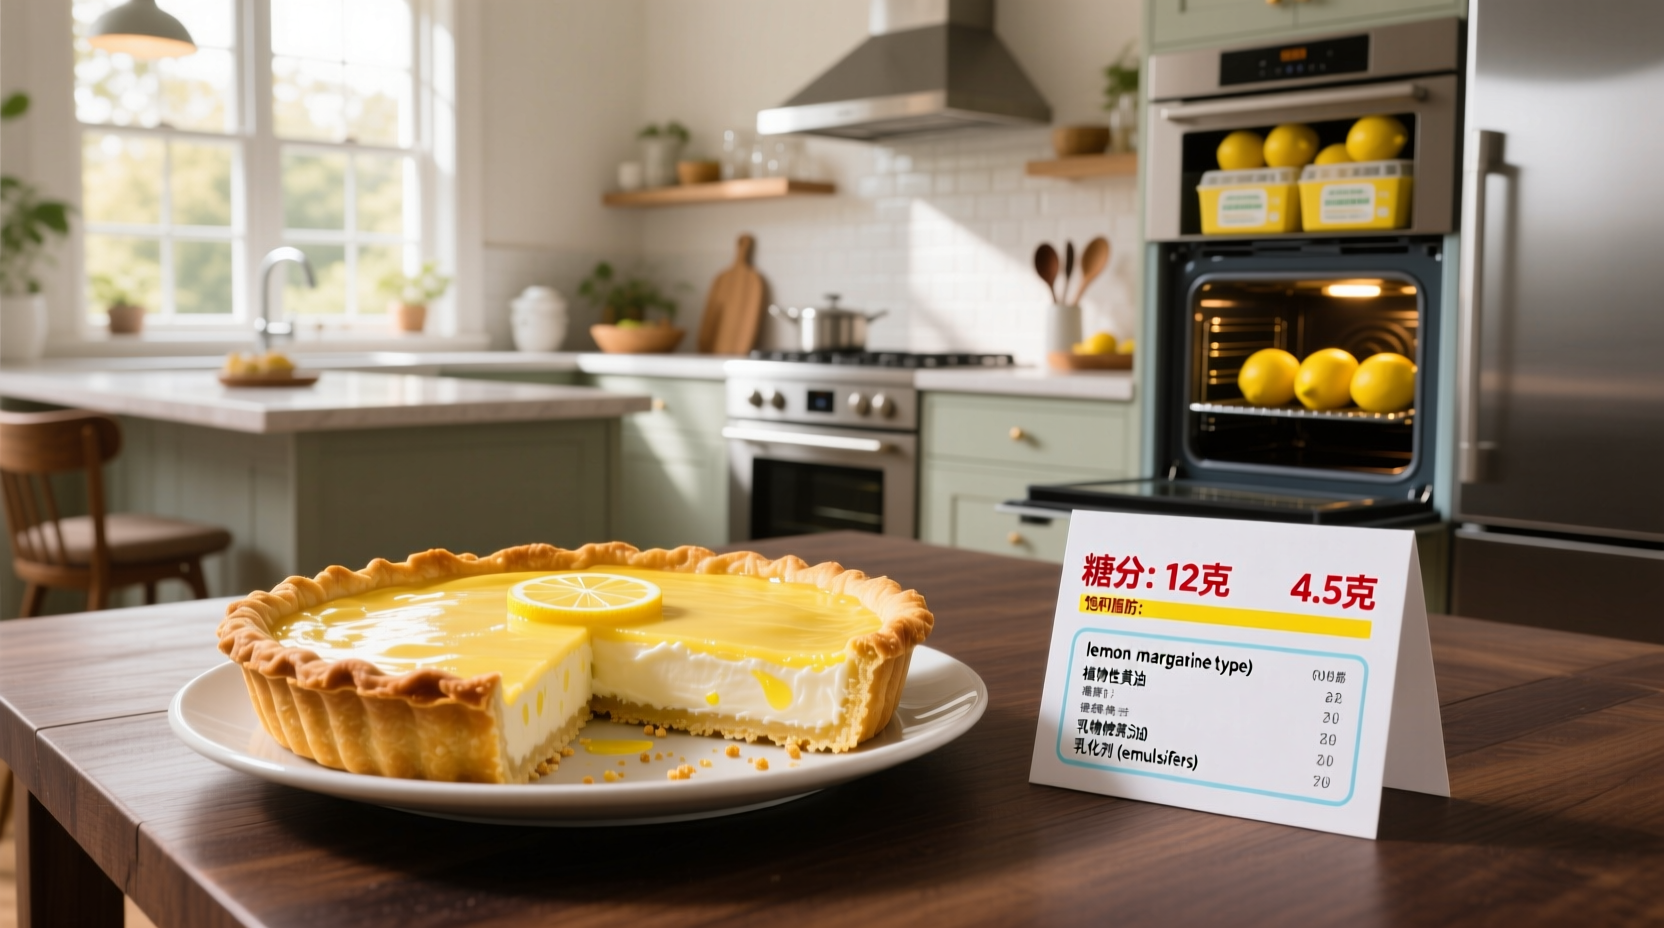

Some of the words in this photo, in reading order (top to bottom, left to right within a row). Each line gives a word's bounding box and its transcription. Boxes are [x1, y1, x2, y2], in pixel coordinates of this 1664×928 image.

[1166, 562, 1233, 598] 12克
[1289, 572, 1379, 611] 4.5克
[1086, 641, 1131, 660] lemon
[1215, 655, 1253, 676] type)
